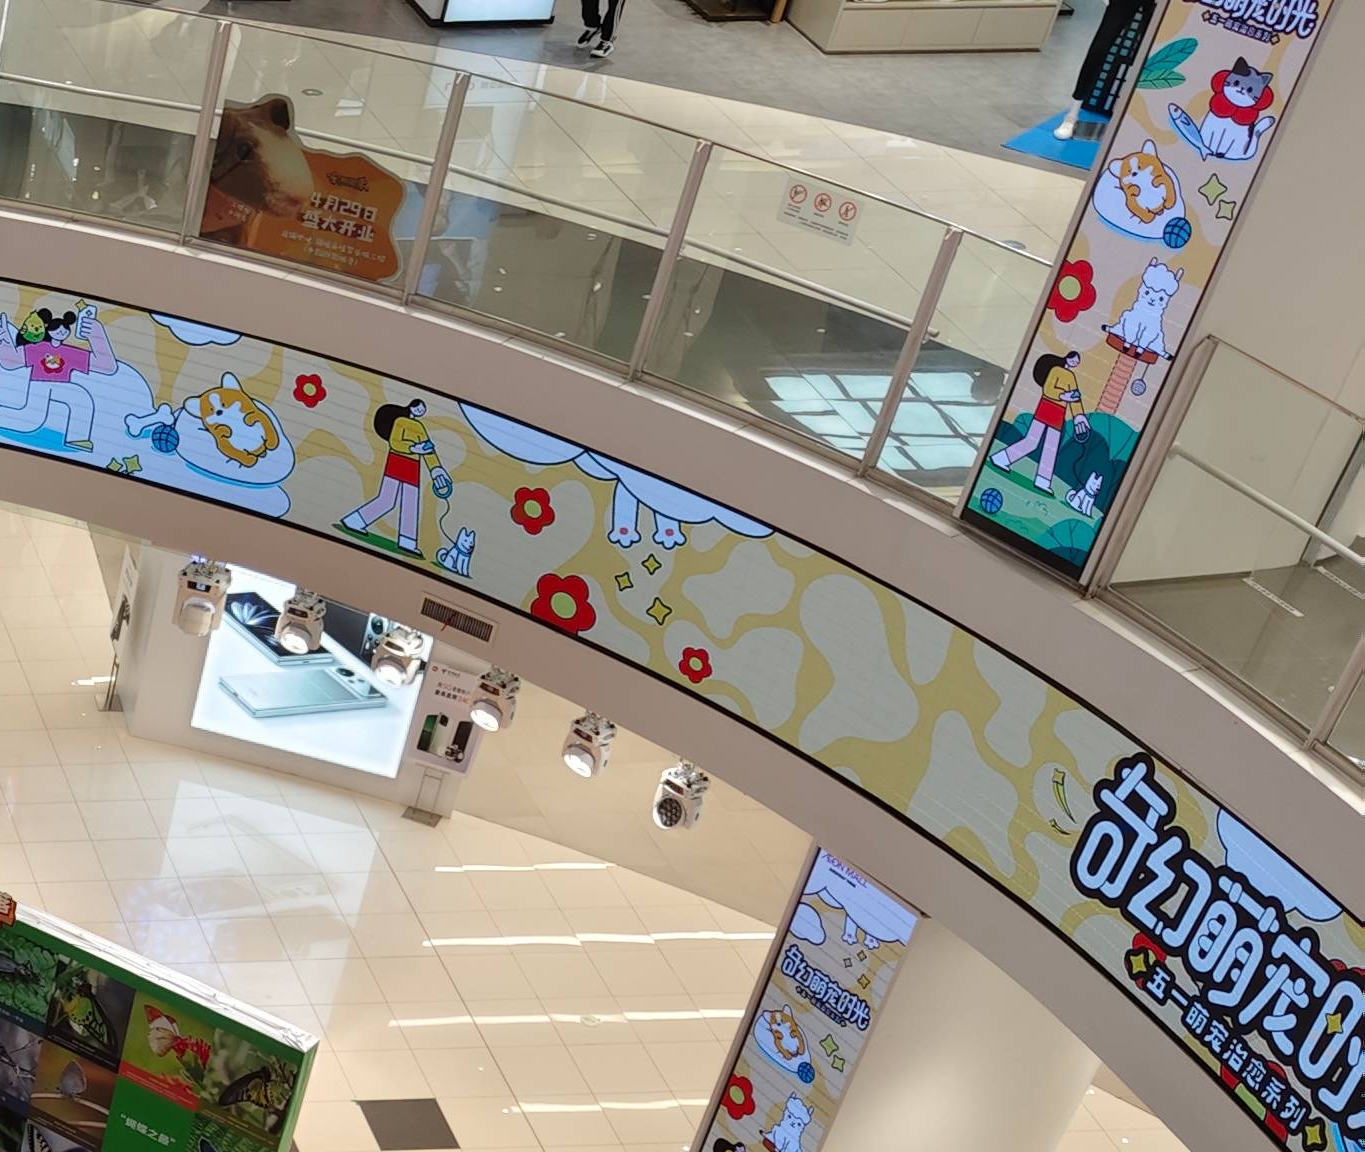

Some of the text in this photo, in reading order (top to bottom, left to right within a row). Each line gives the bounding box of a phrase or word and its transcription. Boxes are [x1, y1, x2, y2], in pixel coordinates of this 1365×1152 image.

[300, 208, 376, 243] 盛大开业
[310, 191, 379, 222] 4月29日
[844, 866, 869, 889] MALL
[1077, 762, 1365, 1132] 奇幻萌宠时
[781, 944, 870, 1030] 奇幻萌宠时光
[1145, 965, 1308, 1127] 五一萌宠治愈系列
